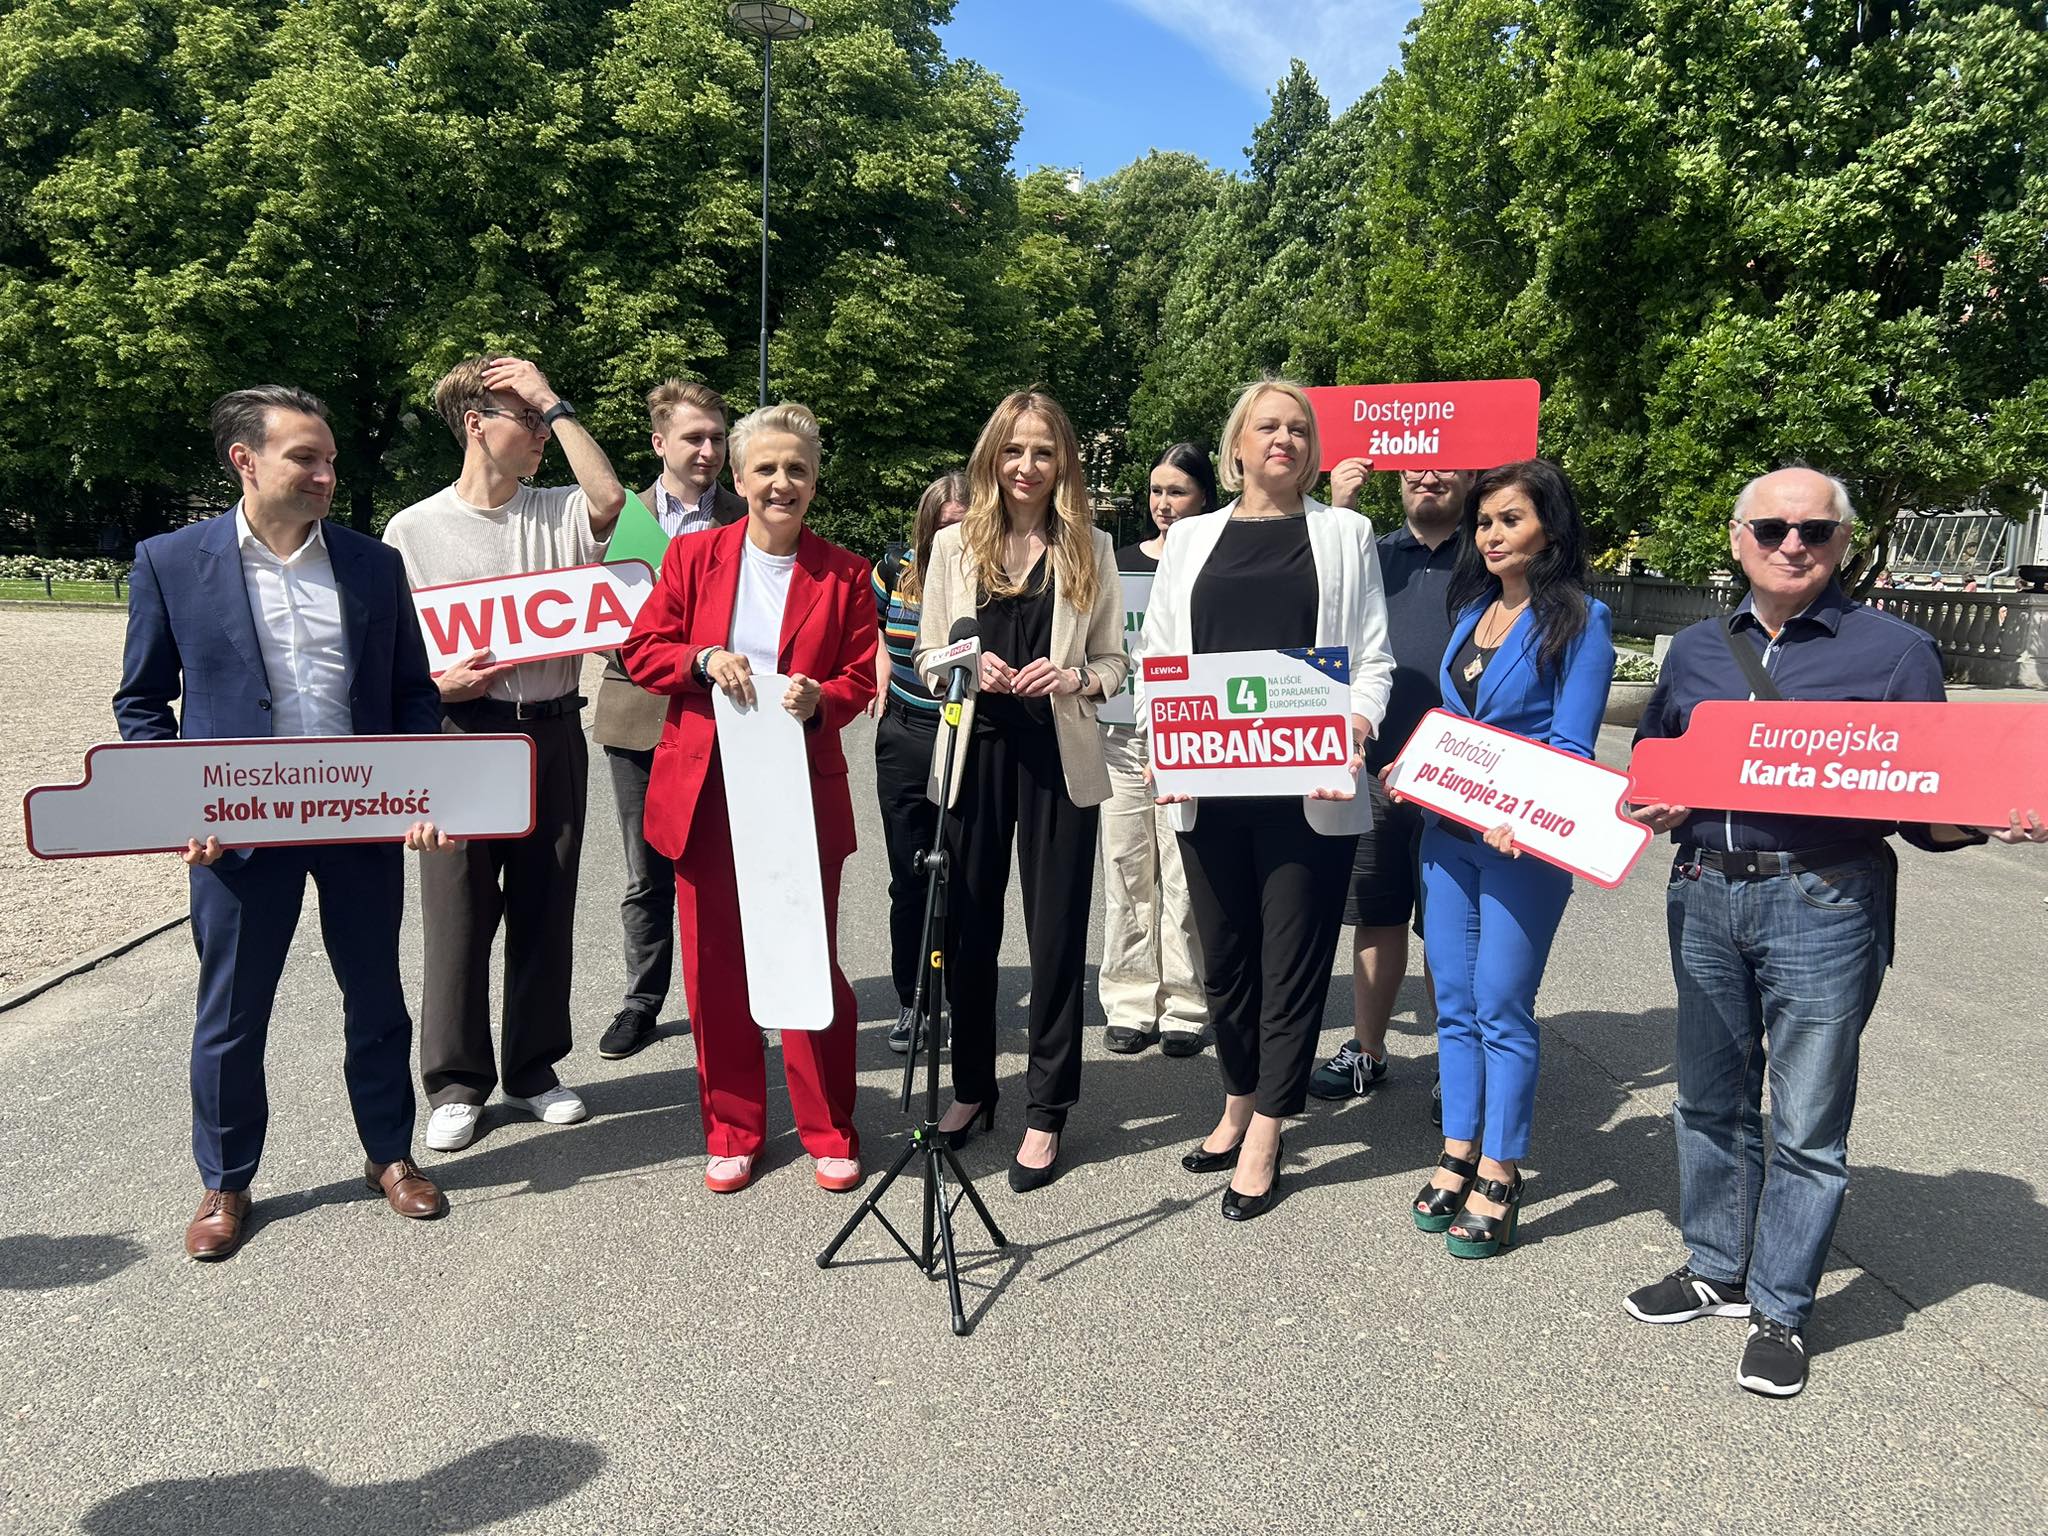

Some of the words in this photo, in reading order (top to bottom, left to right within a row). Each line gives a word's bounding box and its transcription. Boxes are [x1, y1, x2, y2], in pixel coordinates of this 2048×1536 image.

[1353, 399, 1455, 426] Dostępne
[1368, 428, 1440, 456] żłobki
[420, 582, 633, 656] WICA
[950, 643, 971, 655] INFO
[1150, 666, 1182, 674] LEWICA
[1268, 677, 1279, 685] NA
[1280, 674, 1302, 684] LIŚCIE
[1236, 680, 1257, 711] 4
[1268, 689, 1280, 697] DO
[1281, 686, 1330, 696] PARLAMENTU
[1269, 699, 1327, 709] EUROPEJSKIEGO
[1154, 700, 1214, 722] BEATA
[1156, 718, 1344, 766] URBAŃSKA
[1435, 731, 1506, 773] Podróżuj
[1748, 722, 1899, 755] Europejska
[203, 760, 373, 787] Mieszkaniowy
[1739, 759, 1815, 787] Karta
[1822, 760, 1940, 793] Seniora
[204, 797, 267, 822] skok
[273, 801, 293, 819] w
[301, 789, 430, 823] przyszłość
[1414, 761, 1439, 782] po
[1437, 767, 1498, 805] Europie
[1495, 793, 1518, 815] za
[1520, 799, 1534, 819] 1
[1530, 807, 1576, 838] euro
